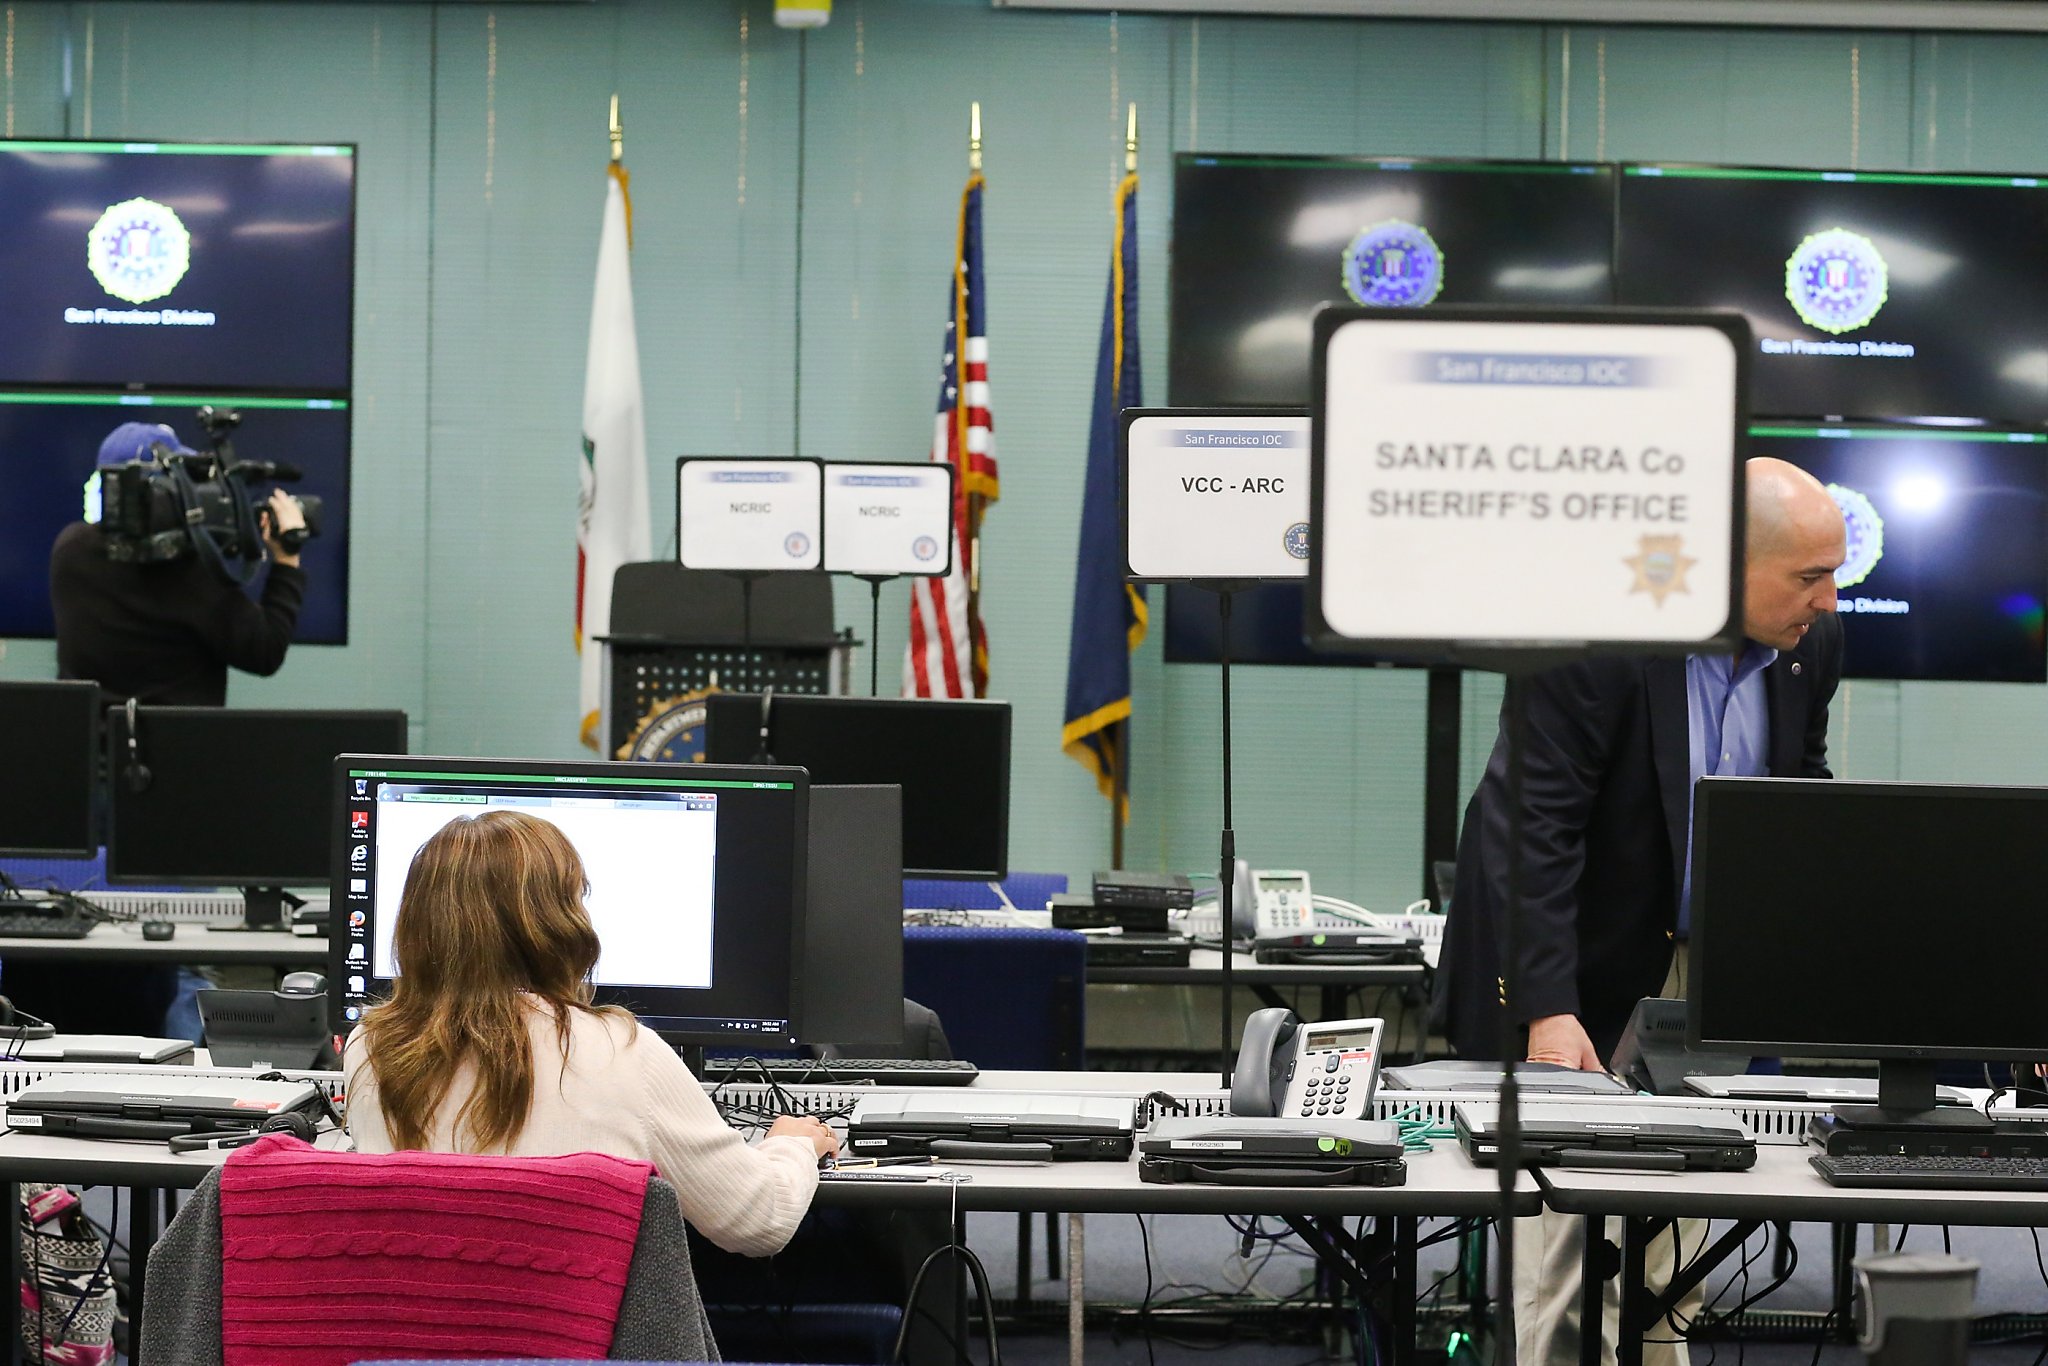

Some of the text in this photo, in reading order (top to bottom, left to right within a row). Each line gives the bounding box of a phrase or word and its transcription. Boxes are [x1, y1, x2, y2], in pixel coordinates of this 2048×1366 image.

[65, 307, 215, 326] San Francisco Division
[1761, 338, 1914, 357] San Francisco Division
[1438, 357, 1630, 384] San Francisco IOC
[1185, 434, 1282, 445] San Francisco IOC
[1376, 442, 1685, 474] SANTA CLARA Co
[1181, 477, 1223, 493] VCC
[1241, 478, 1285, 494] ARC
[729, 502, 771, 513] NCRIC
[859, 506, 900, 517] NCRIC
[1369, 489, 1688, 522] SHERIFF'S OFFICE
[1854, 597, 1910, 614] Division
